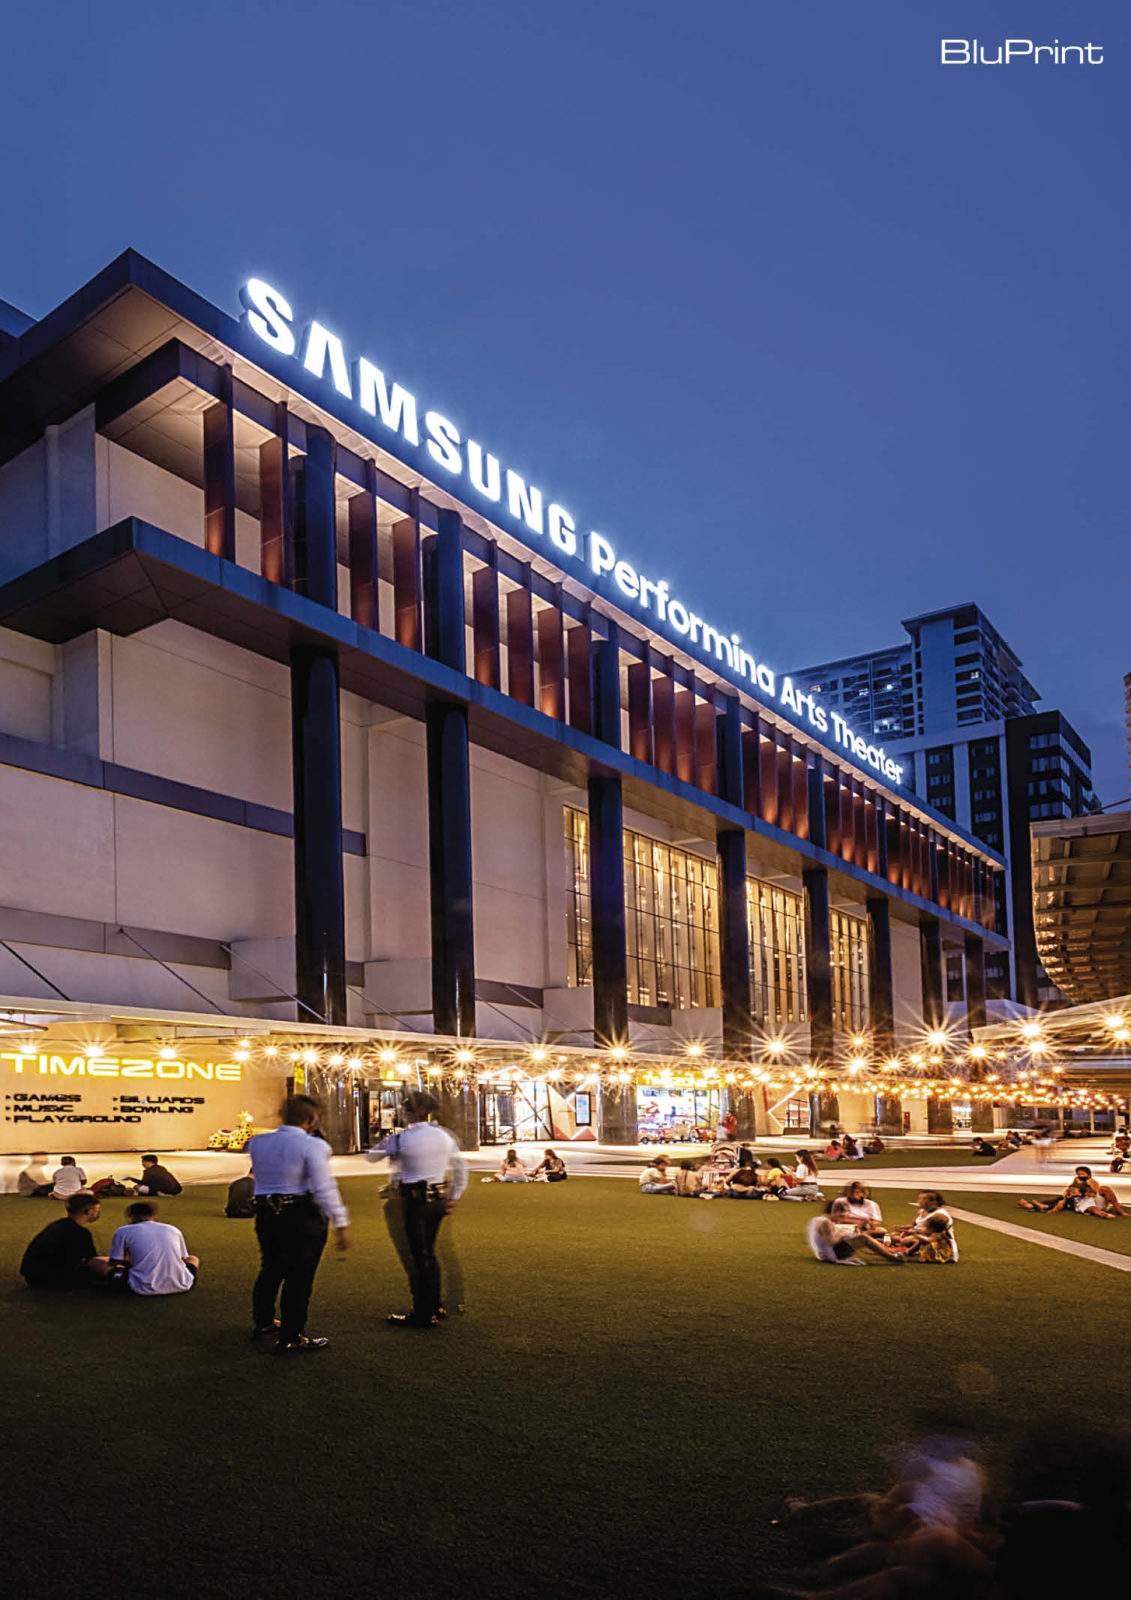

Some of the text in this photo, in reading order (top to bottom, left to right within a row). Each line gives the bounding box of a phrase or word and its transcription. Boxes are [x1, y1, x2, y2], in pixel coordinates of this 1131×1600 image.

[245, 277, 578, 556] SAMSUNG
[779, 676, 828, 734] Arts
[830, 711, 904, 785] Theater
[0, 1053, 242, 1081] TIMEZONE
[13, 1093, 82, 1102] GAMES
[13, 1104, 194, 1114] MUSIC BOWLING
[13, 1114, 142, 1124] PLAYGROUND
